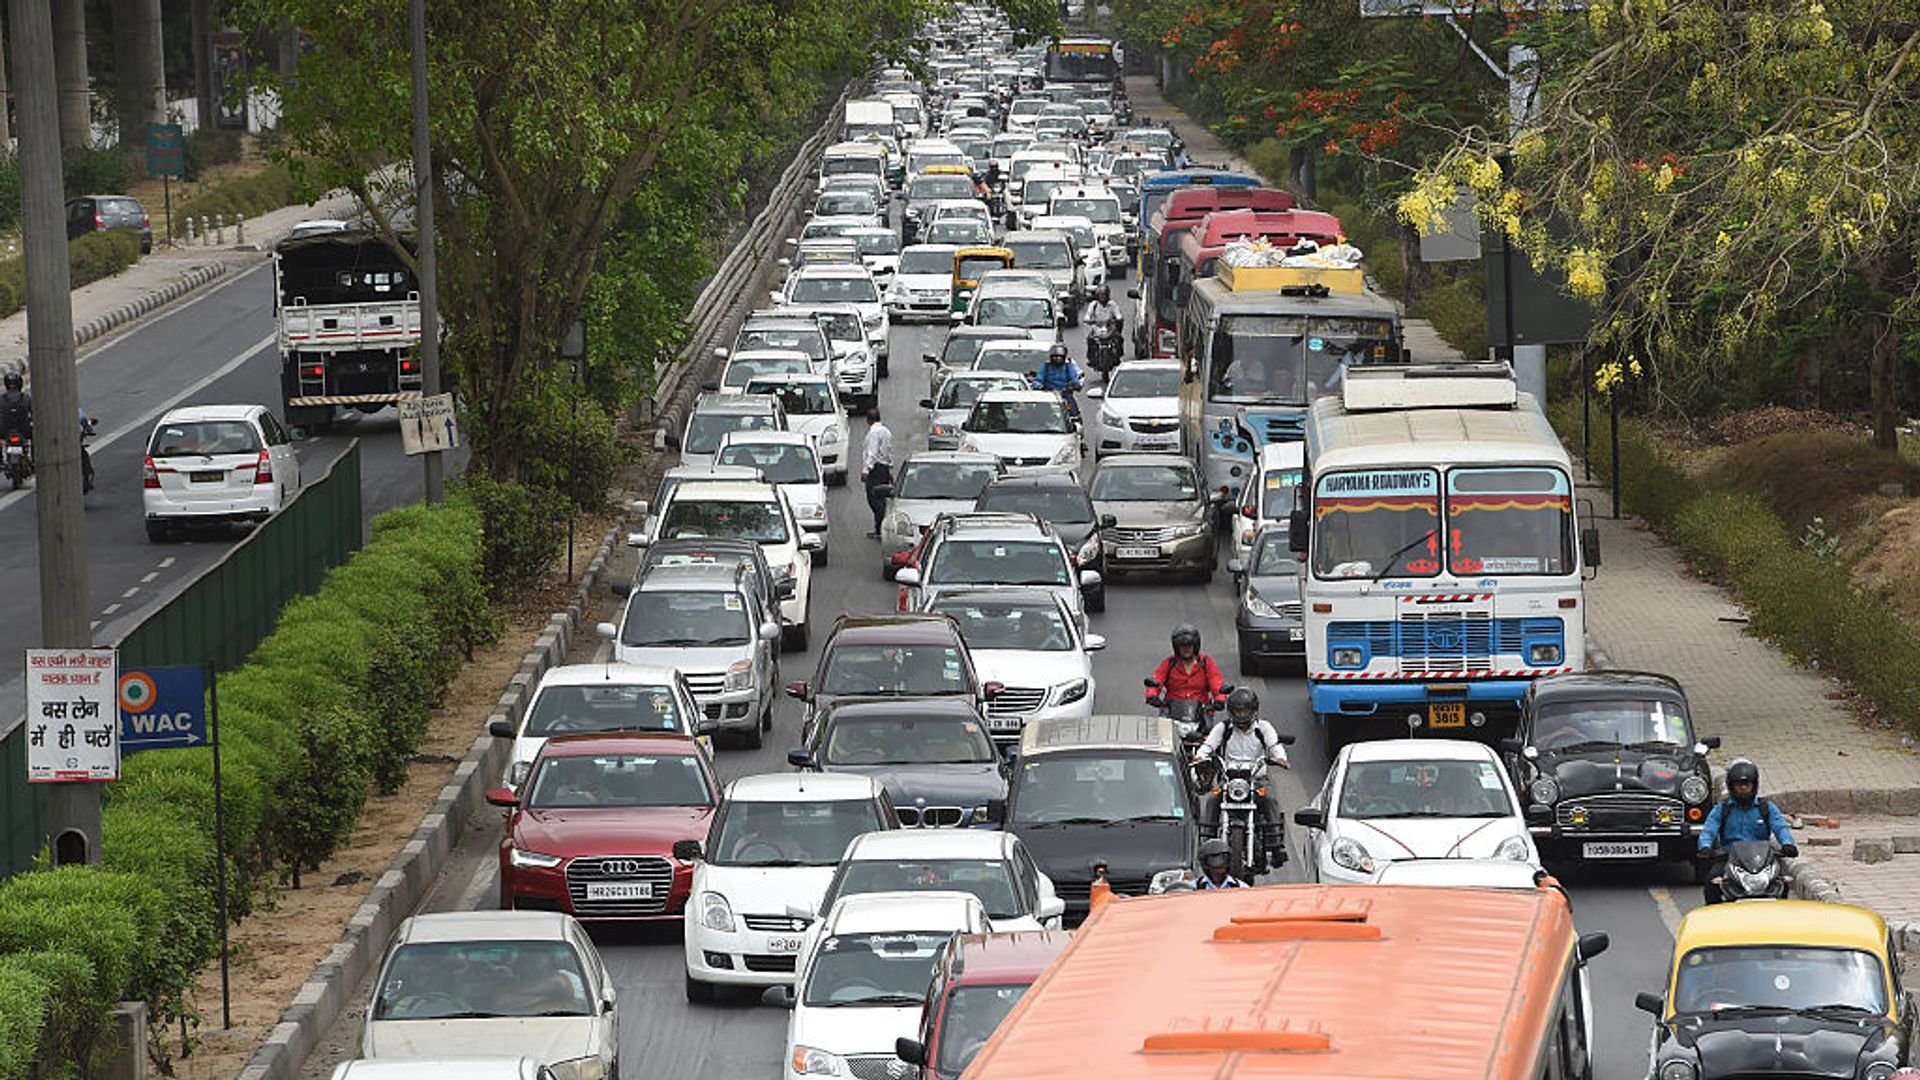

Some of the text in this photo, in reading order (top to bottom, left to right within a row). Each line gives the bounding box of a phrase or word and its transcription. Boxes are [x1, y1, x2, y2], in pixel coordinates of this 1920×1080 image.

[1326, 476, 1370, 492] HARYANA
[42, 695, 99, 719] बस लेन
[131, 711, 193, 734] WAC
[30, 723, 47, 748] में
[58, 723, 75, 749] ही
[84, 723, 113, 748] चलें
